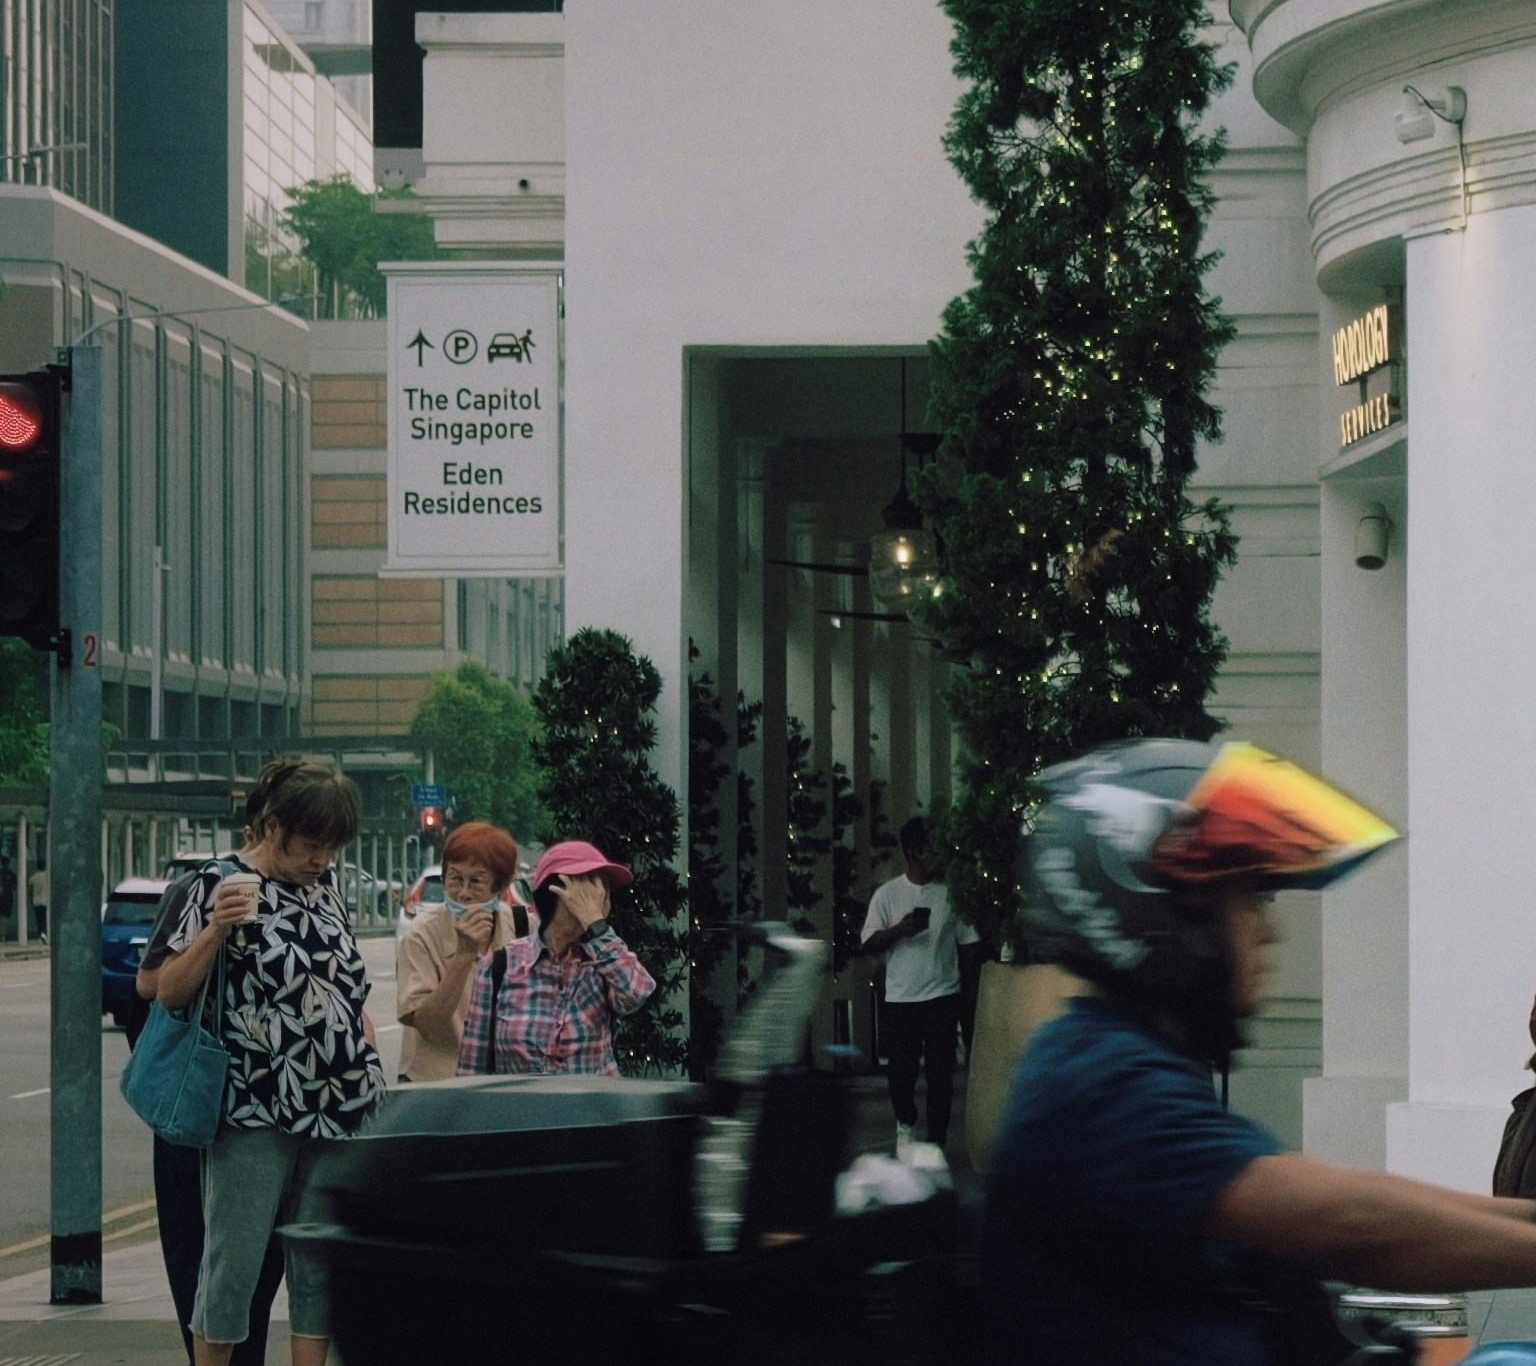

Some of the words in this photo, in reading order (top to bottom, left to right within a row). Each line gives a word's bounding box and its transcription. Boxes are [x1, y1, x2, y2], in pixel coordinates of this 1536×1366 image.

[1333, 304, 1389, 387] HOROLOGY
[403, 389, 448, 411] The
[456, 388, 542, 417] Capitol
[410, 417, 534, 446] Singapore
[1341, 393, 1390, 446] SERVICES
[443, 463, 503, 486] Eden
[403, 492, 542, 515] Residences
[83, 634, 96, 667] 2
